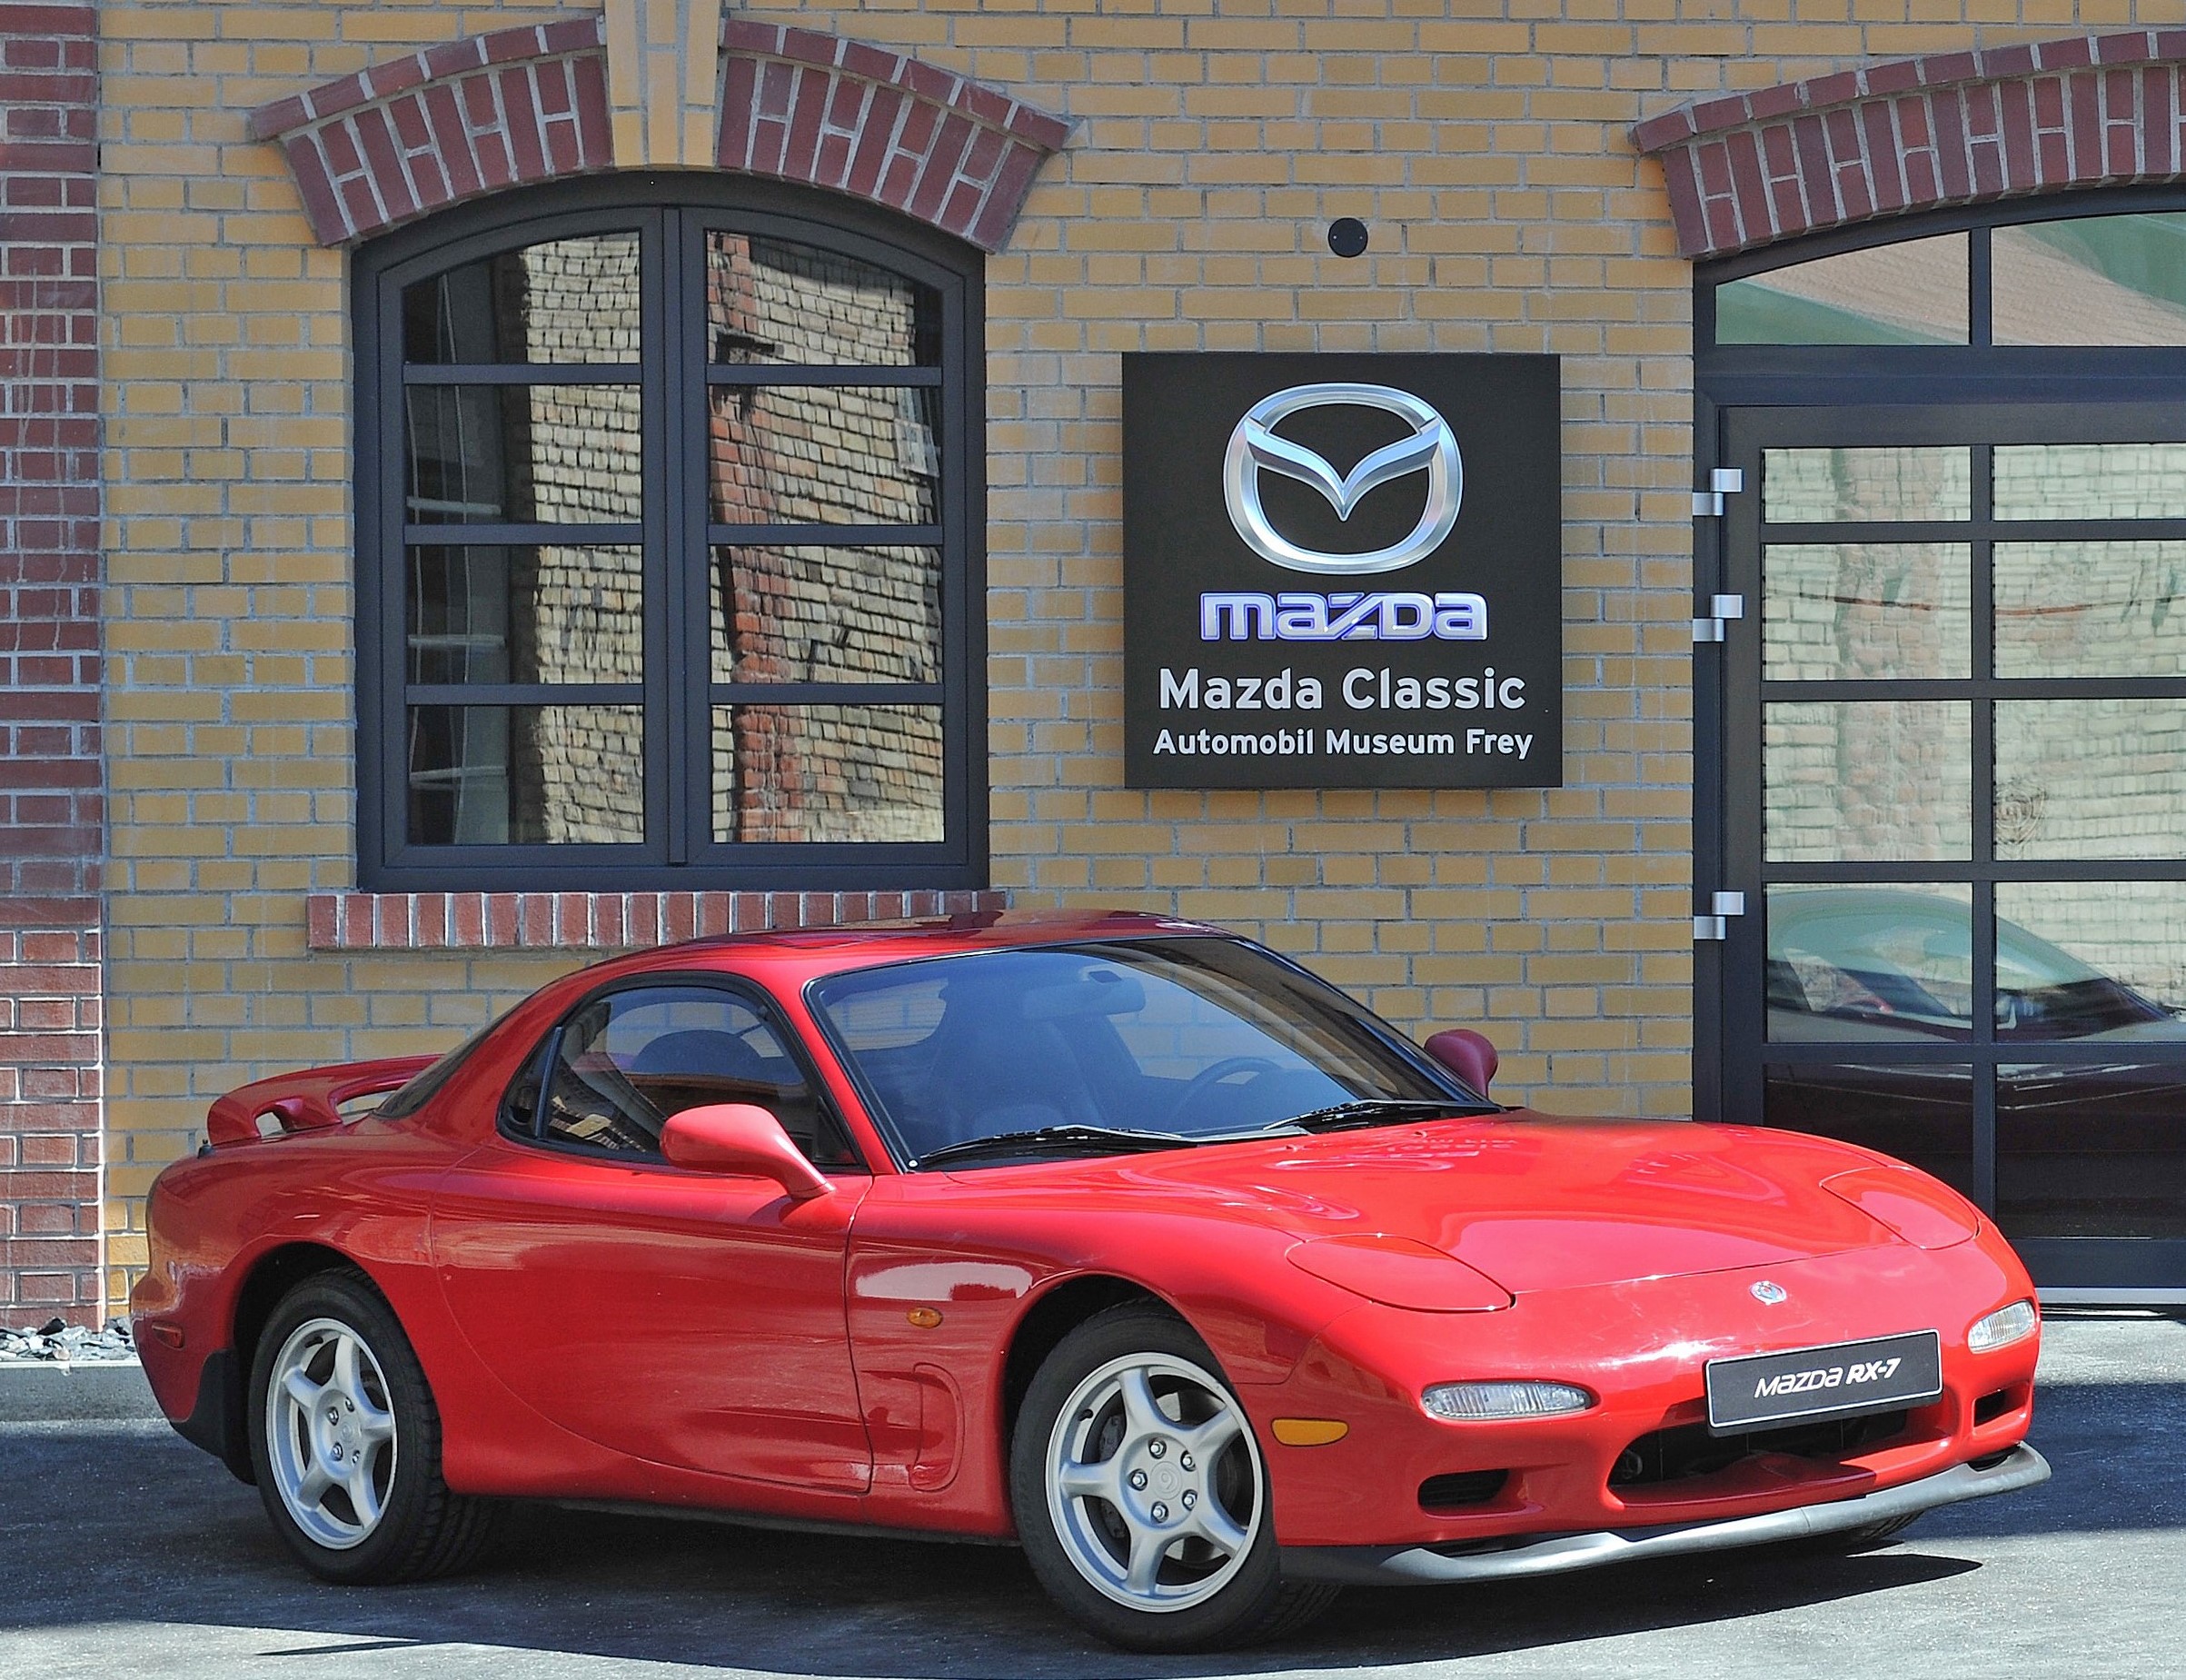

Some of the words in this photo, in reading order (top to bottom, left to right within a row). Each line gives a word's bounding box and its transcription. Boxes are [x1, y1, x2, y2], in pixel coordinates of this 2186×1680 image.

[1159, 668, 1322, 710] Mazda
[1343, 668, 1525, 710] Classic
[1153, 729, 1314, 754] Automobil
[1327, 729, 1455, 754] Museum
[1467, 729, 1534, 760] Frey
[1754, 1367, 1843, 1398] Mazda
[1844, 1357, 1902, 1385] RX-7
